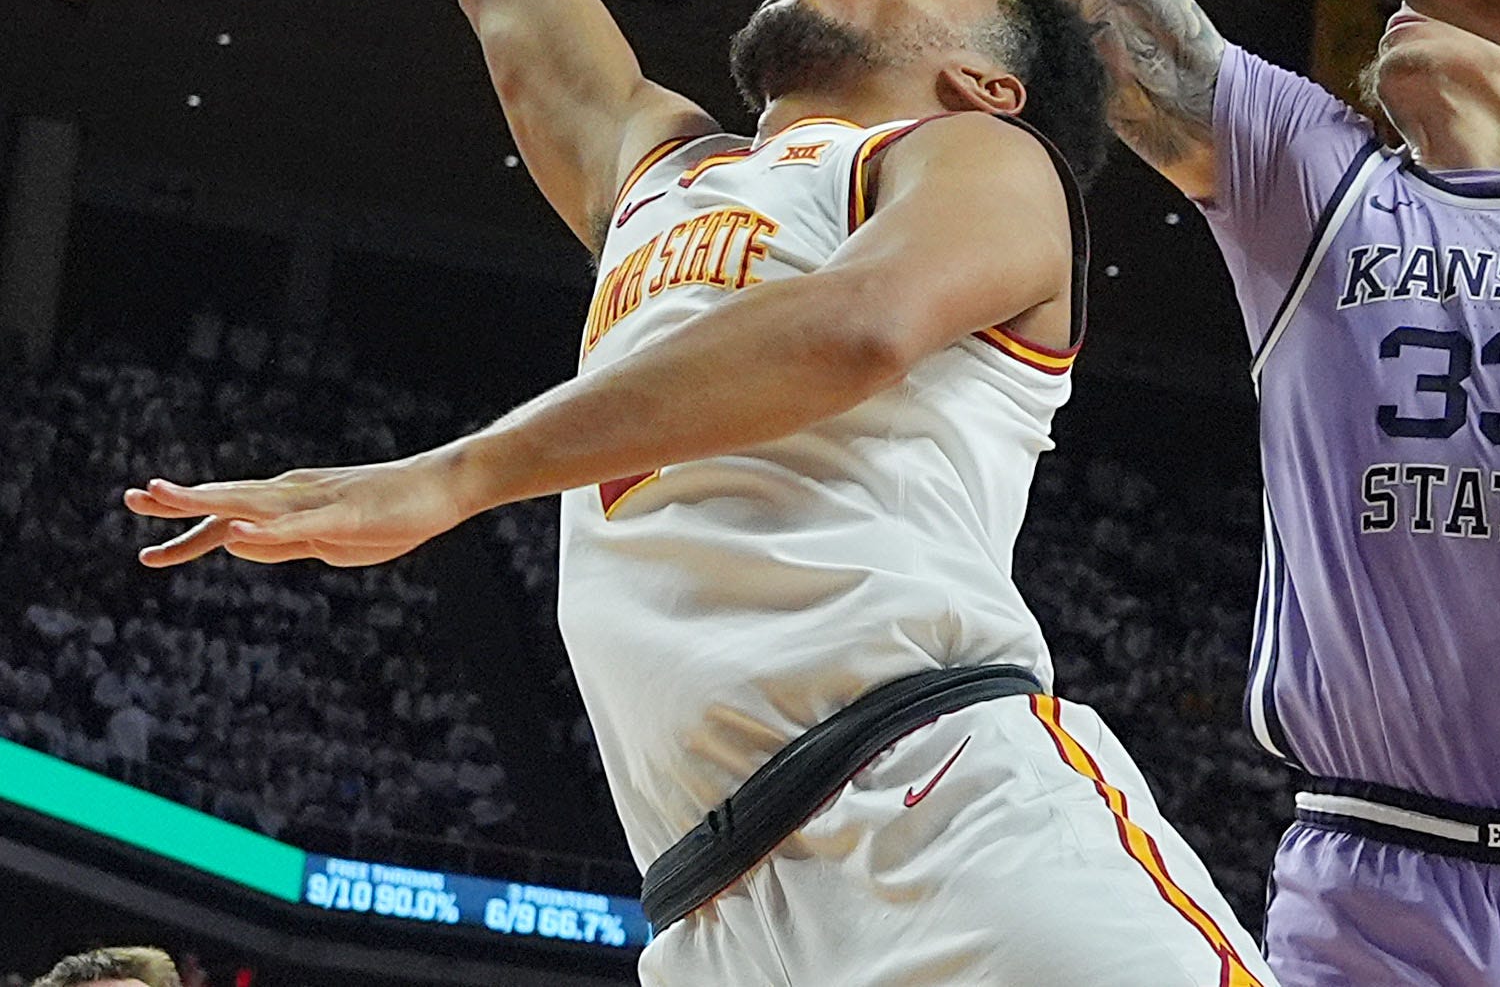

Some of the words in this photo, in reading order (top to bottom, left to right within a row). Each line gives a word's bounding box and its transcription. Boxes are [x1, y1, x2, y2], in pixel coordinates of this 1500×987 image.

[648, 205, 779, 297] STATE
[306, 872, 373, 913] 9/10
[373, 884, 460, 925] 90.0%
[537, 908, 627, 948] 66.7%
